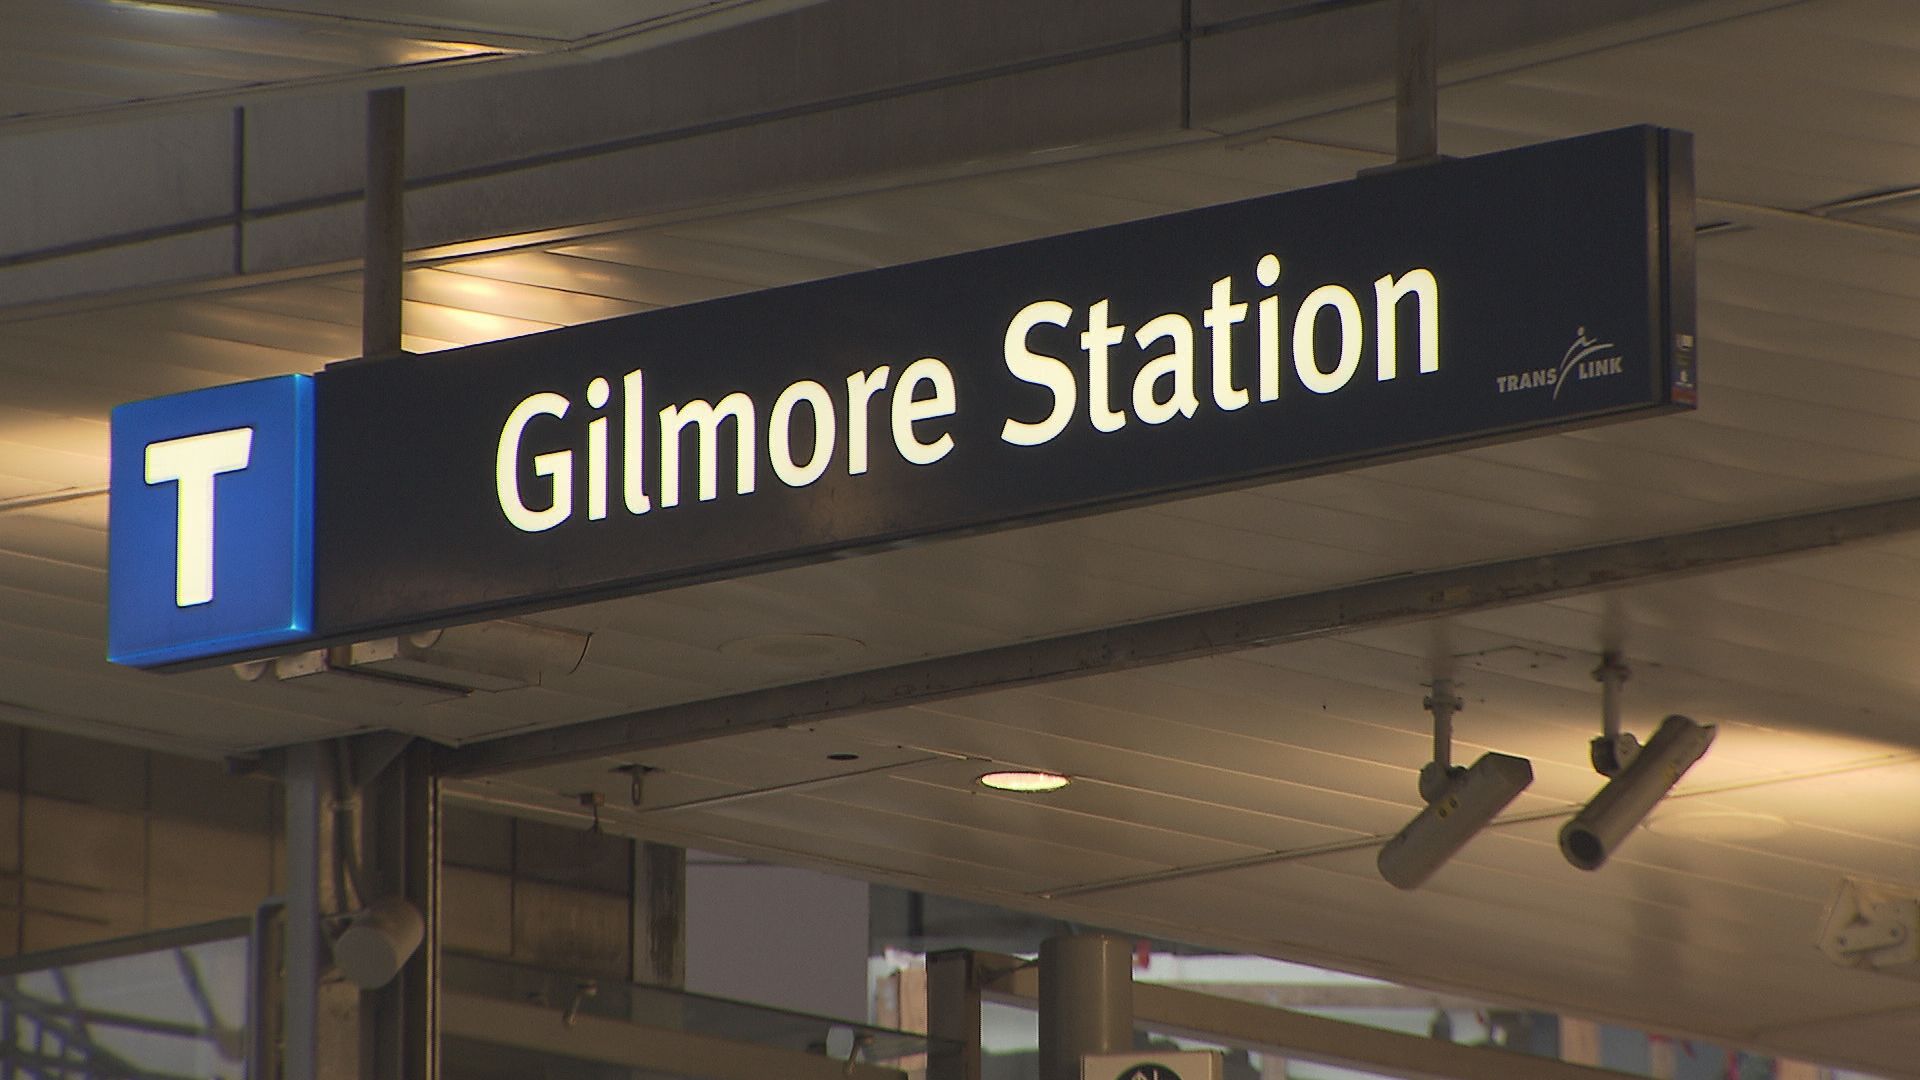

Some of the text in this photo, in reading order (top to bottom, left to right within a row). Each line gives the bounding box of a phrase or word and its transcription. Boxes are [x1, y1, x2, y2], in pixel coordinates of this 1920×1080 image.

[495, 254, 1440, 533] Gilmore Station
[1496, 356, 1623, 393] TRANS LINK
[144, 426, 254, 608] T
